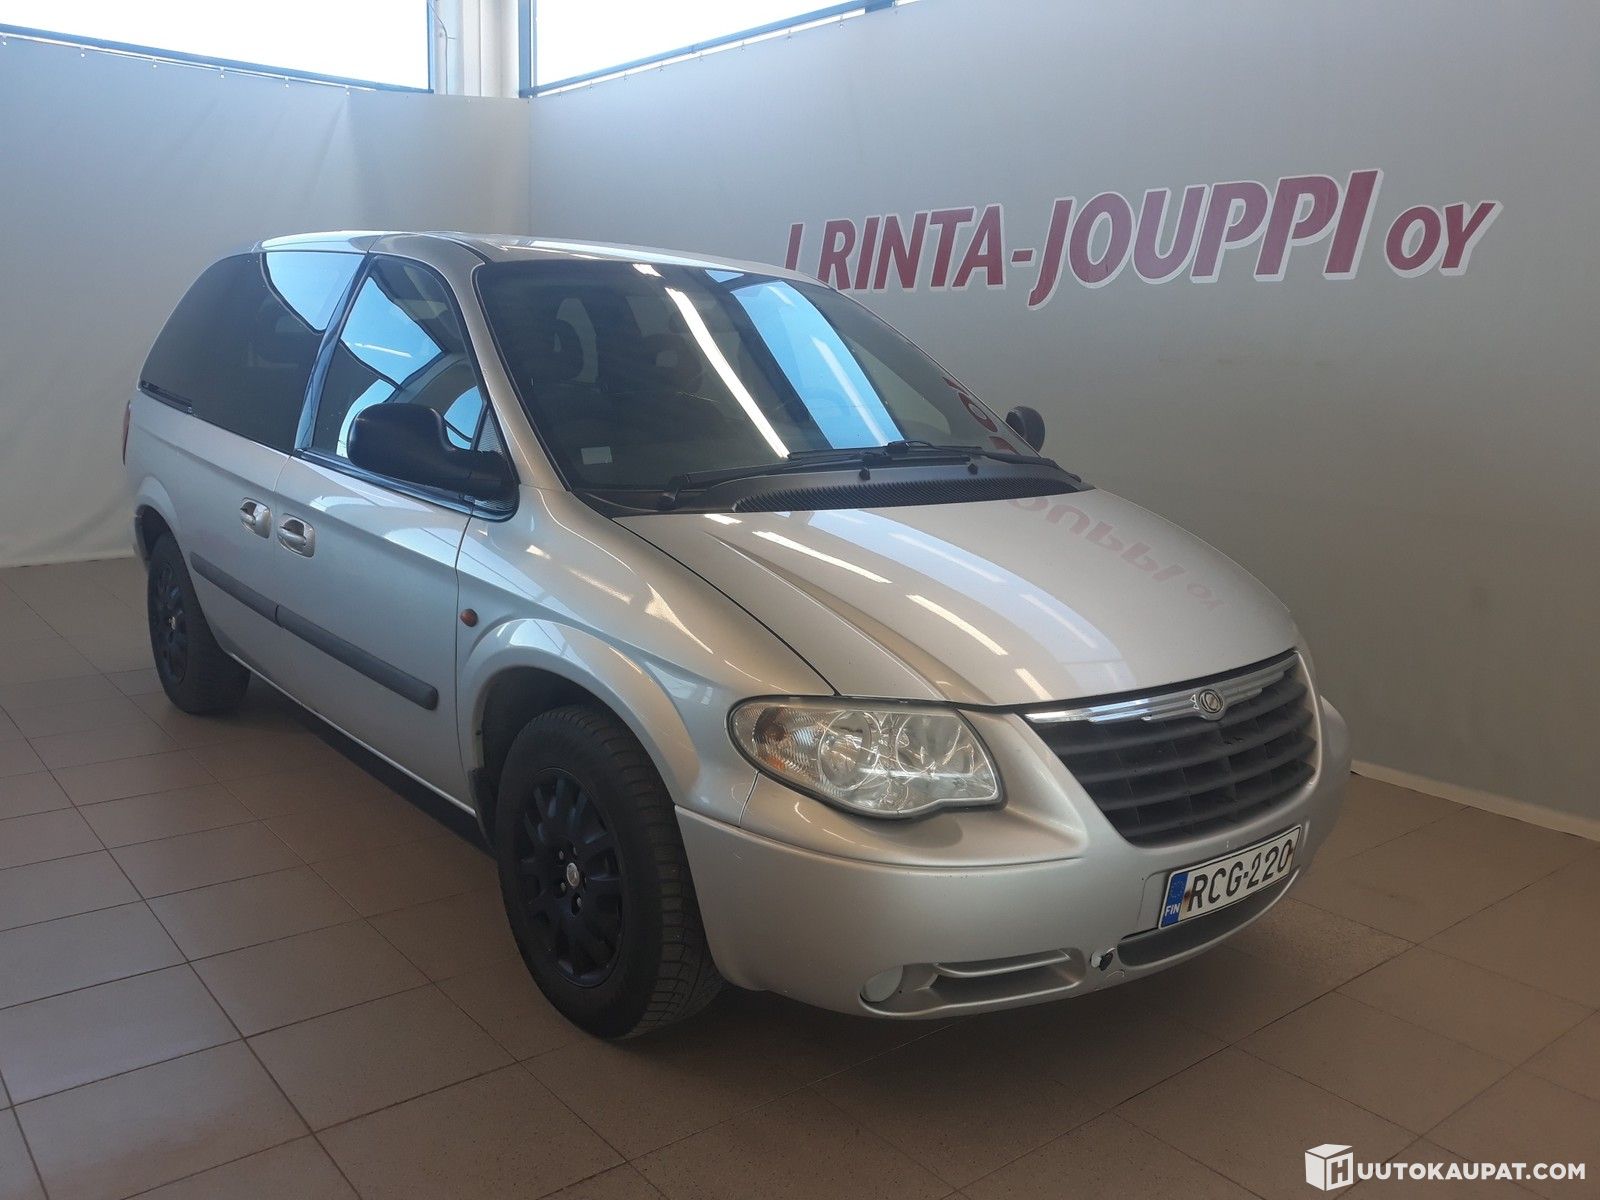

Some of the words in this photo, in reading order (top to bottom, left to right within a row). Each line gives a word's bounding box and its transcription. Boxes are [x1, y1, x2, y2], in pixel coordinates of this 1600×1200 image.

[816, 169, 1383, 310] RINTA-JOUPPI
[1386, 201, 1502, 278] OY
[1165, 903, 1181, 916] FIN
[1187, 838, 1293, 913] RCG-220
